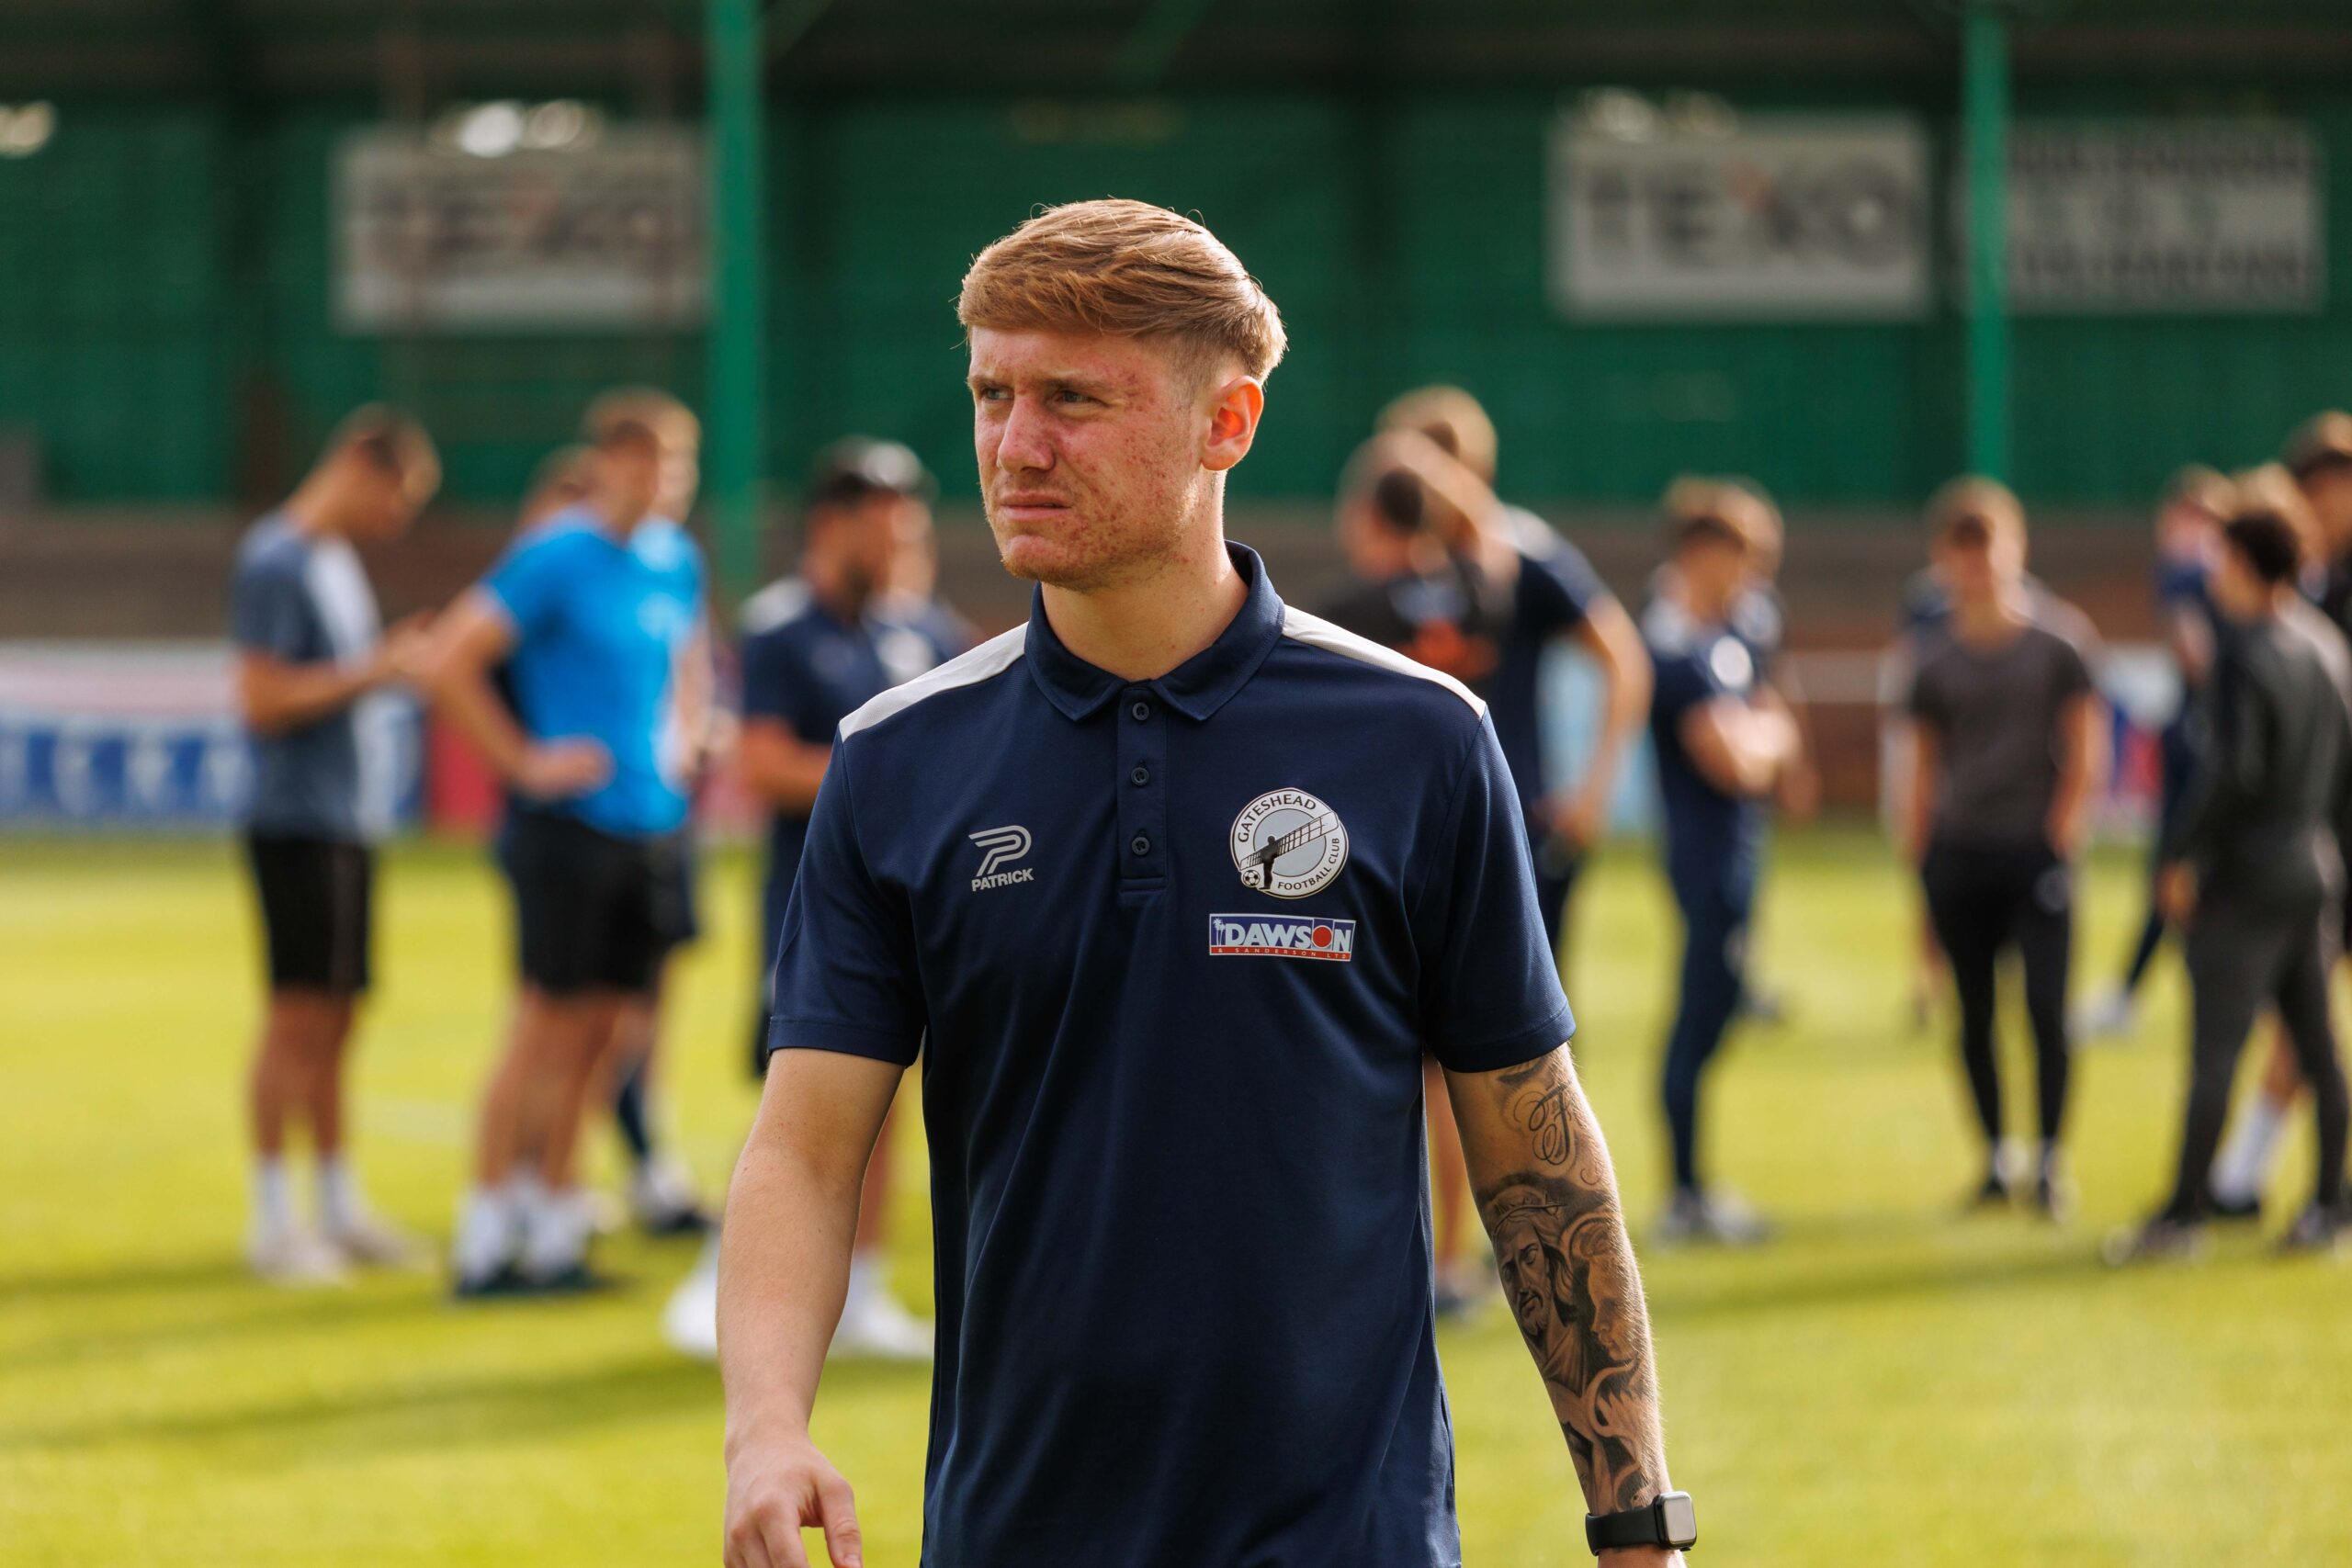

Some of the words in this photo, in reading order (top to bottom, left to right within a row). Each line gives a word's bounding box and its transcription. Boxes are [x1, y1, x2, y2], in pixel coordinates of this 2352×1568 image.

[1238, 794, 1317, 842] GATESHEAD
[1277, 866, 1331, 891] FOOTBALL
[1329, 837, 1340, 864] CLUB
[971, 868, 1035, 892] PATRICK
[1225, 923, 1351, 953] DAWSON
[1235, 948, 1317, 957] SANDERSON
